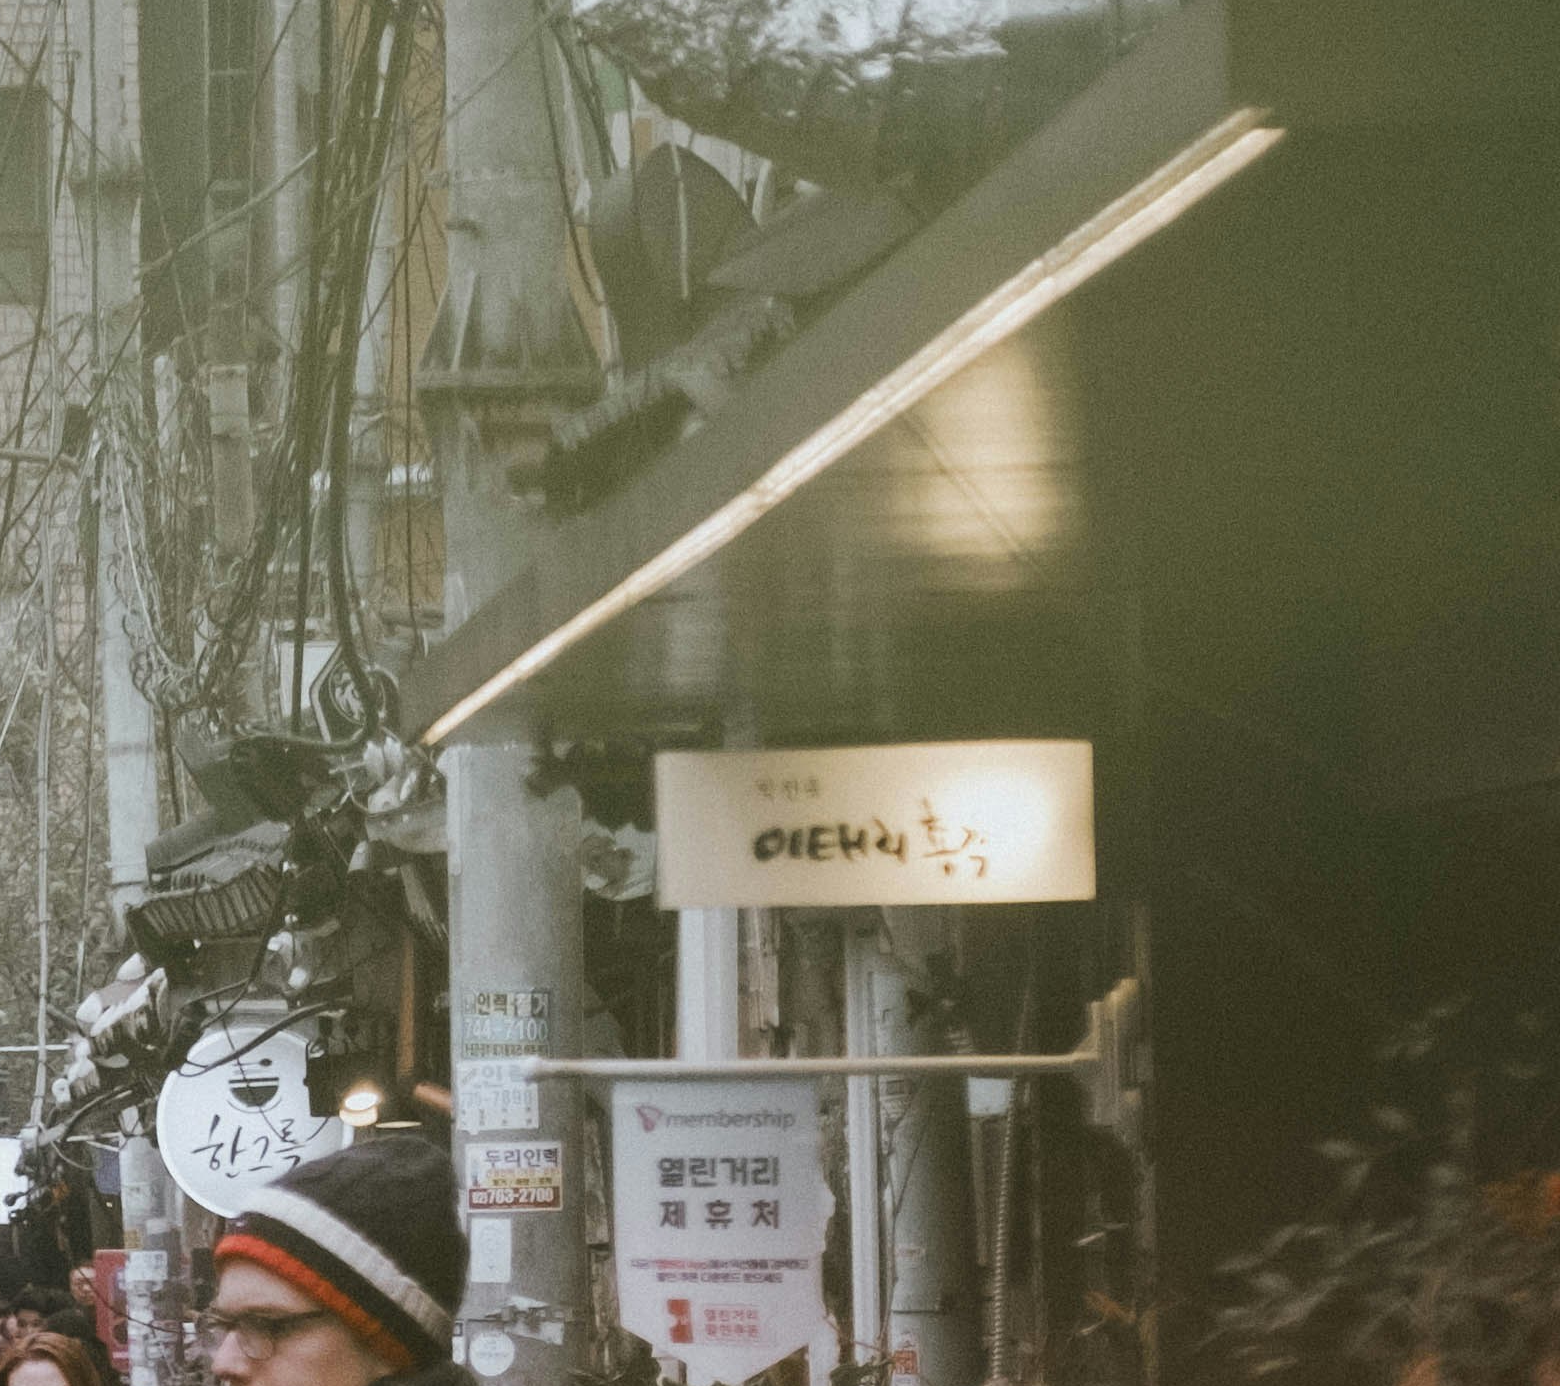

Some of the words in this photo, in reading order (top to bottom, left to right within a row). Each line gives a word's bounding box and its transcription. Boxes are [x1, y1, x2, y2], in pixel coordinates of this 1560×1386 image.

[665, 1108, 797, 1131] membership
[483, 1148, 558, 1168] 두리인력
[657, 1156, 780, 1188] 열린거리
